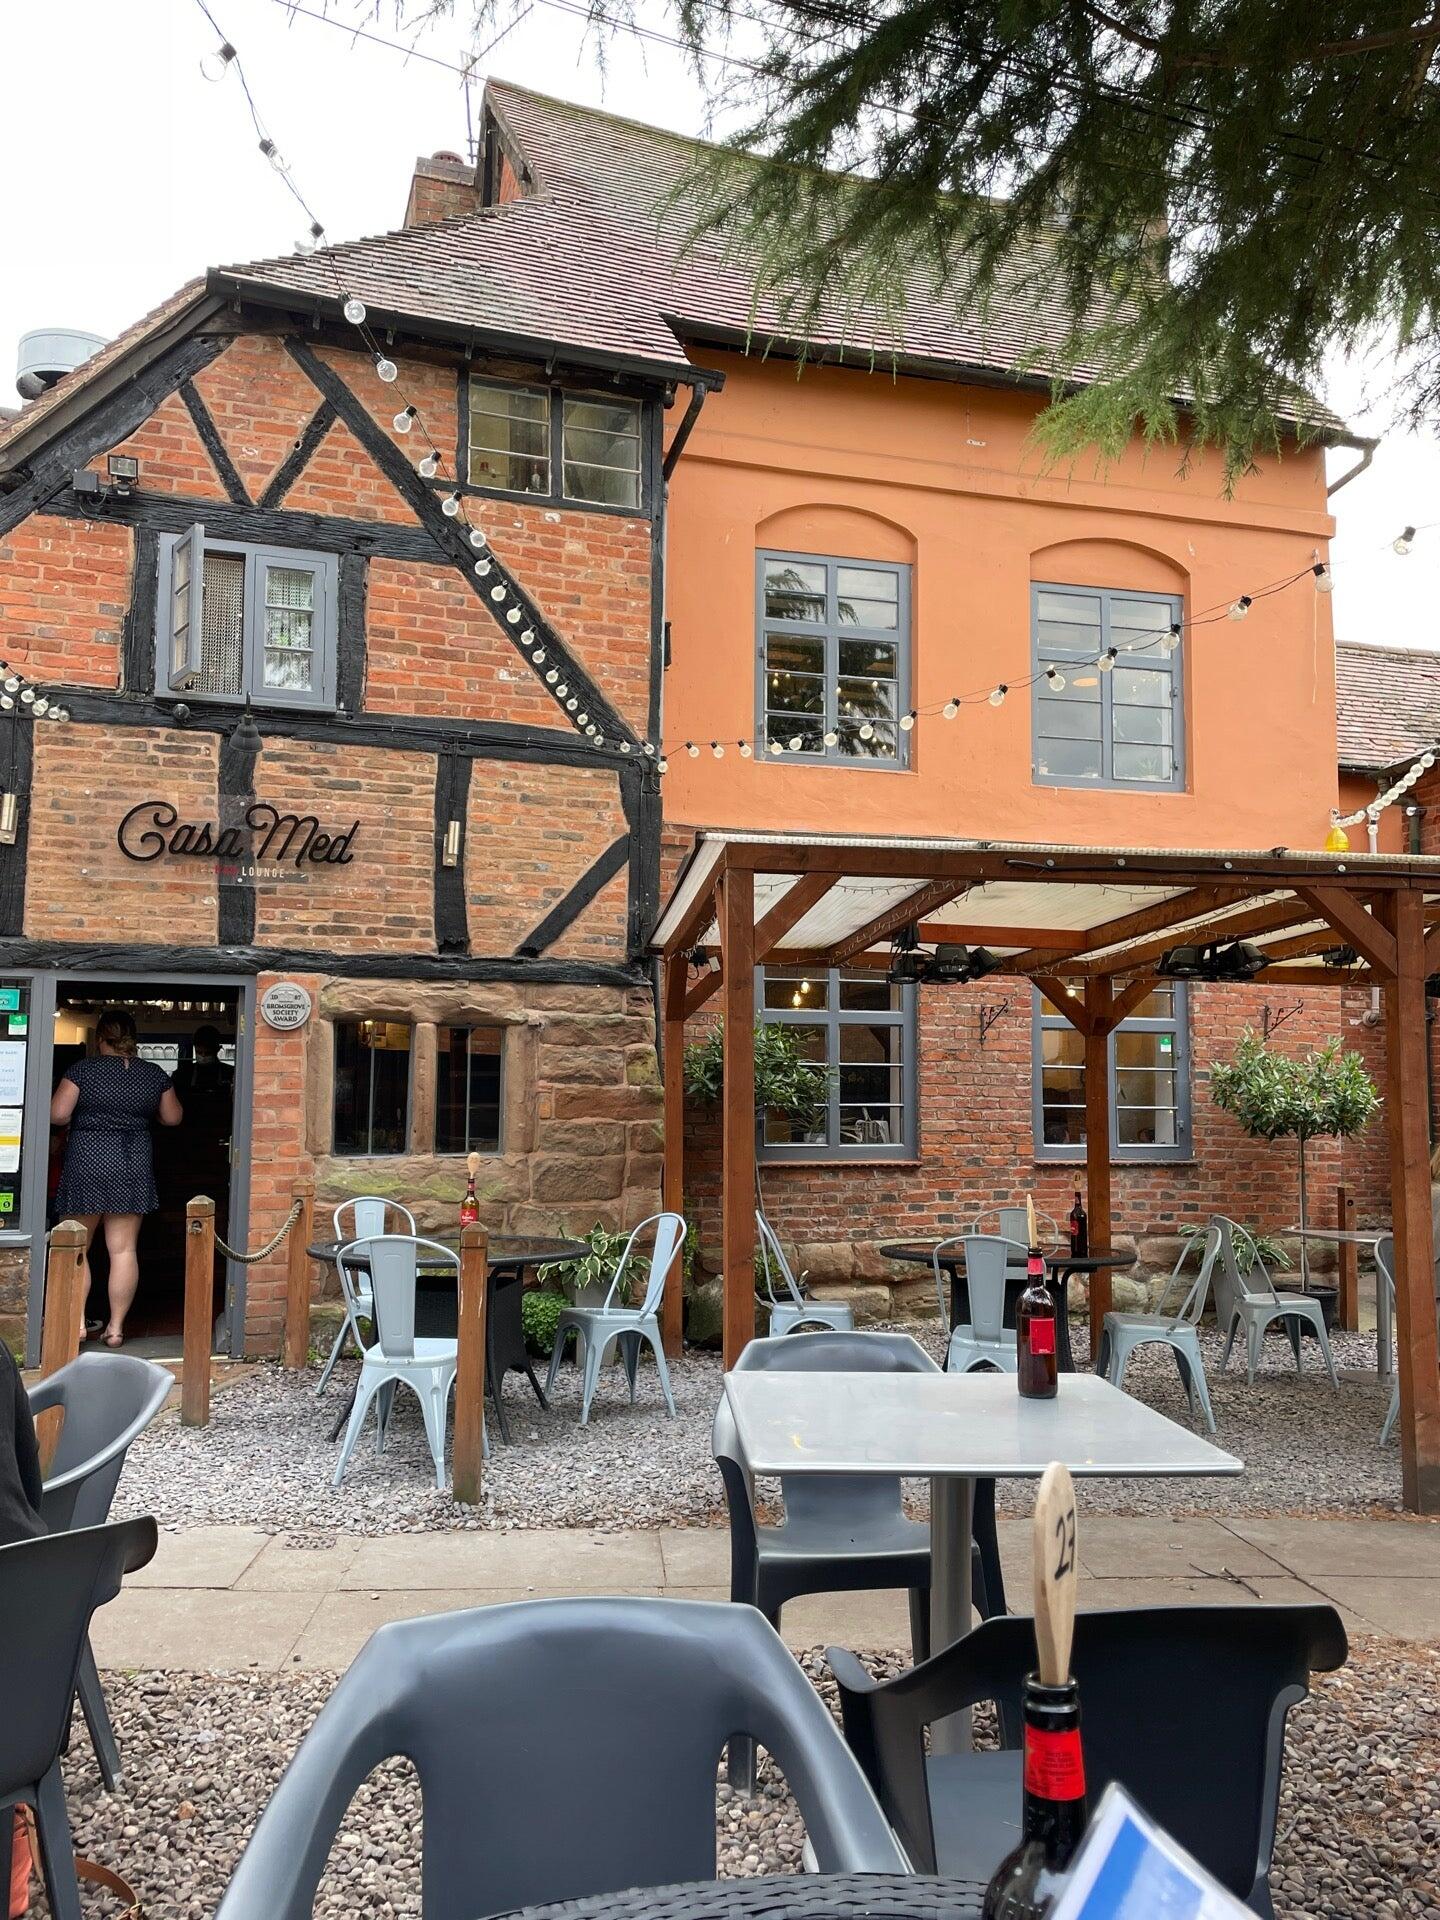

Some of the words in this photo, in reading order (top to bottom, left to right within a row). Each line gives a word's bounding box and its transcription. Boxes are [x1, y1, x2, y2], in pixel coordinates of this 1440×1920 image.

[117, 800, 244, 862] Casa
[245, 803, 361, 868] Med
[241, 866, 285, 879] LOUNGE
